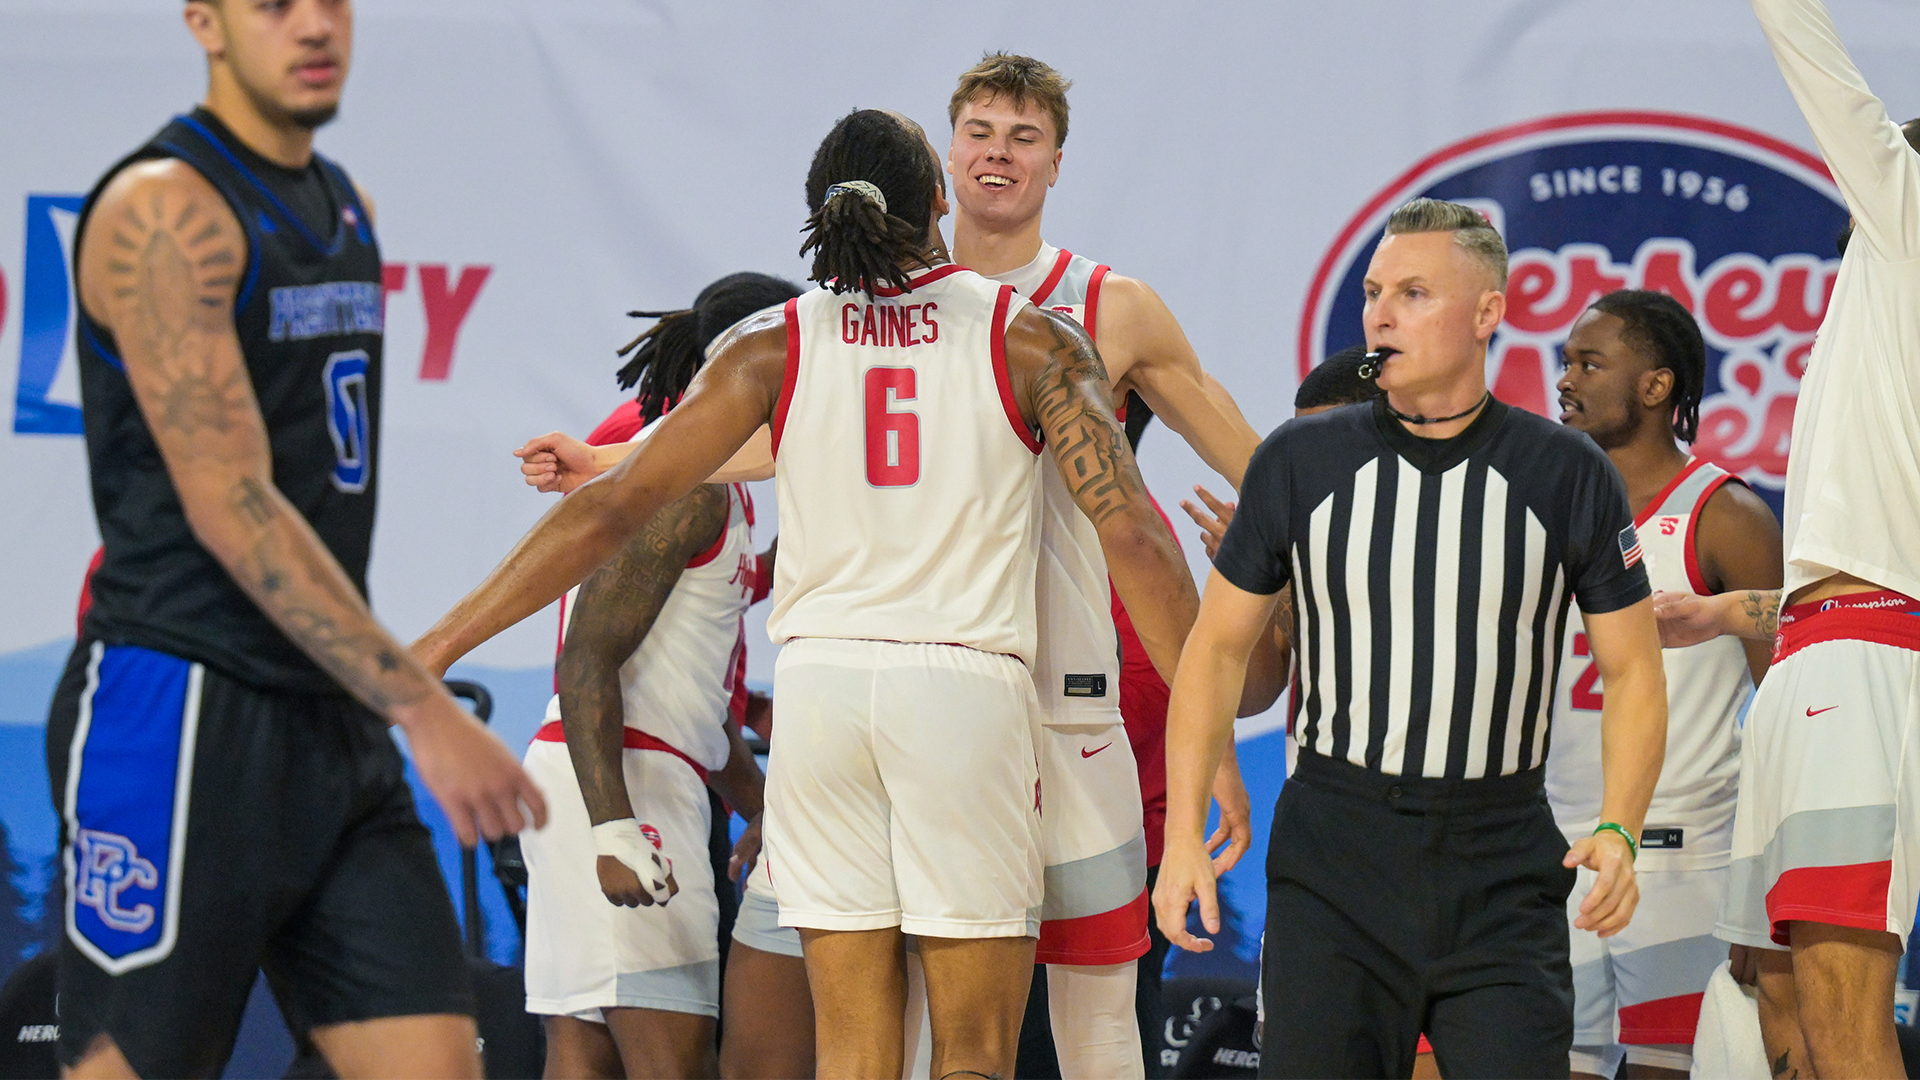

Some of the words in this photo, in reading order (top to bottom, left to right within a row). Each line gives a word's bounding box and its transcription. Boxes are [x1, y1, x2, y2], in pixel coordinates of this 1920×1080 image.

[1529, 164, 1643, 202] SINCE
[1660, 166, 1750, 212] 1956
[842, 303, 938, 347] GAINES
[1499, 248, 1837, 379] ersey
[322, 349, 370, 494] 0
[862, 364, 922, 489] 6
[1668, 833, 1677, 842] M
